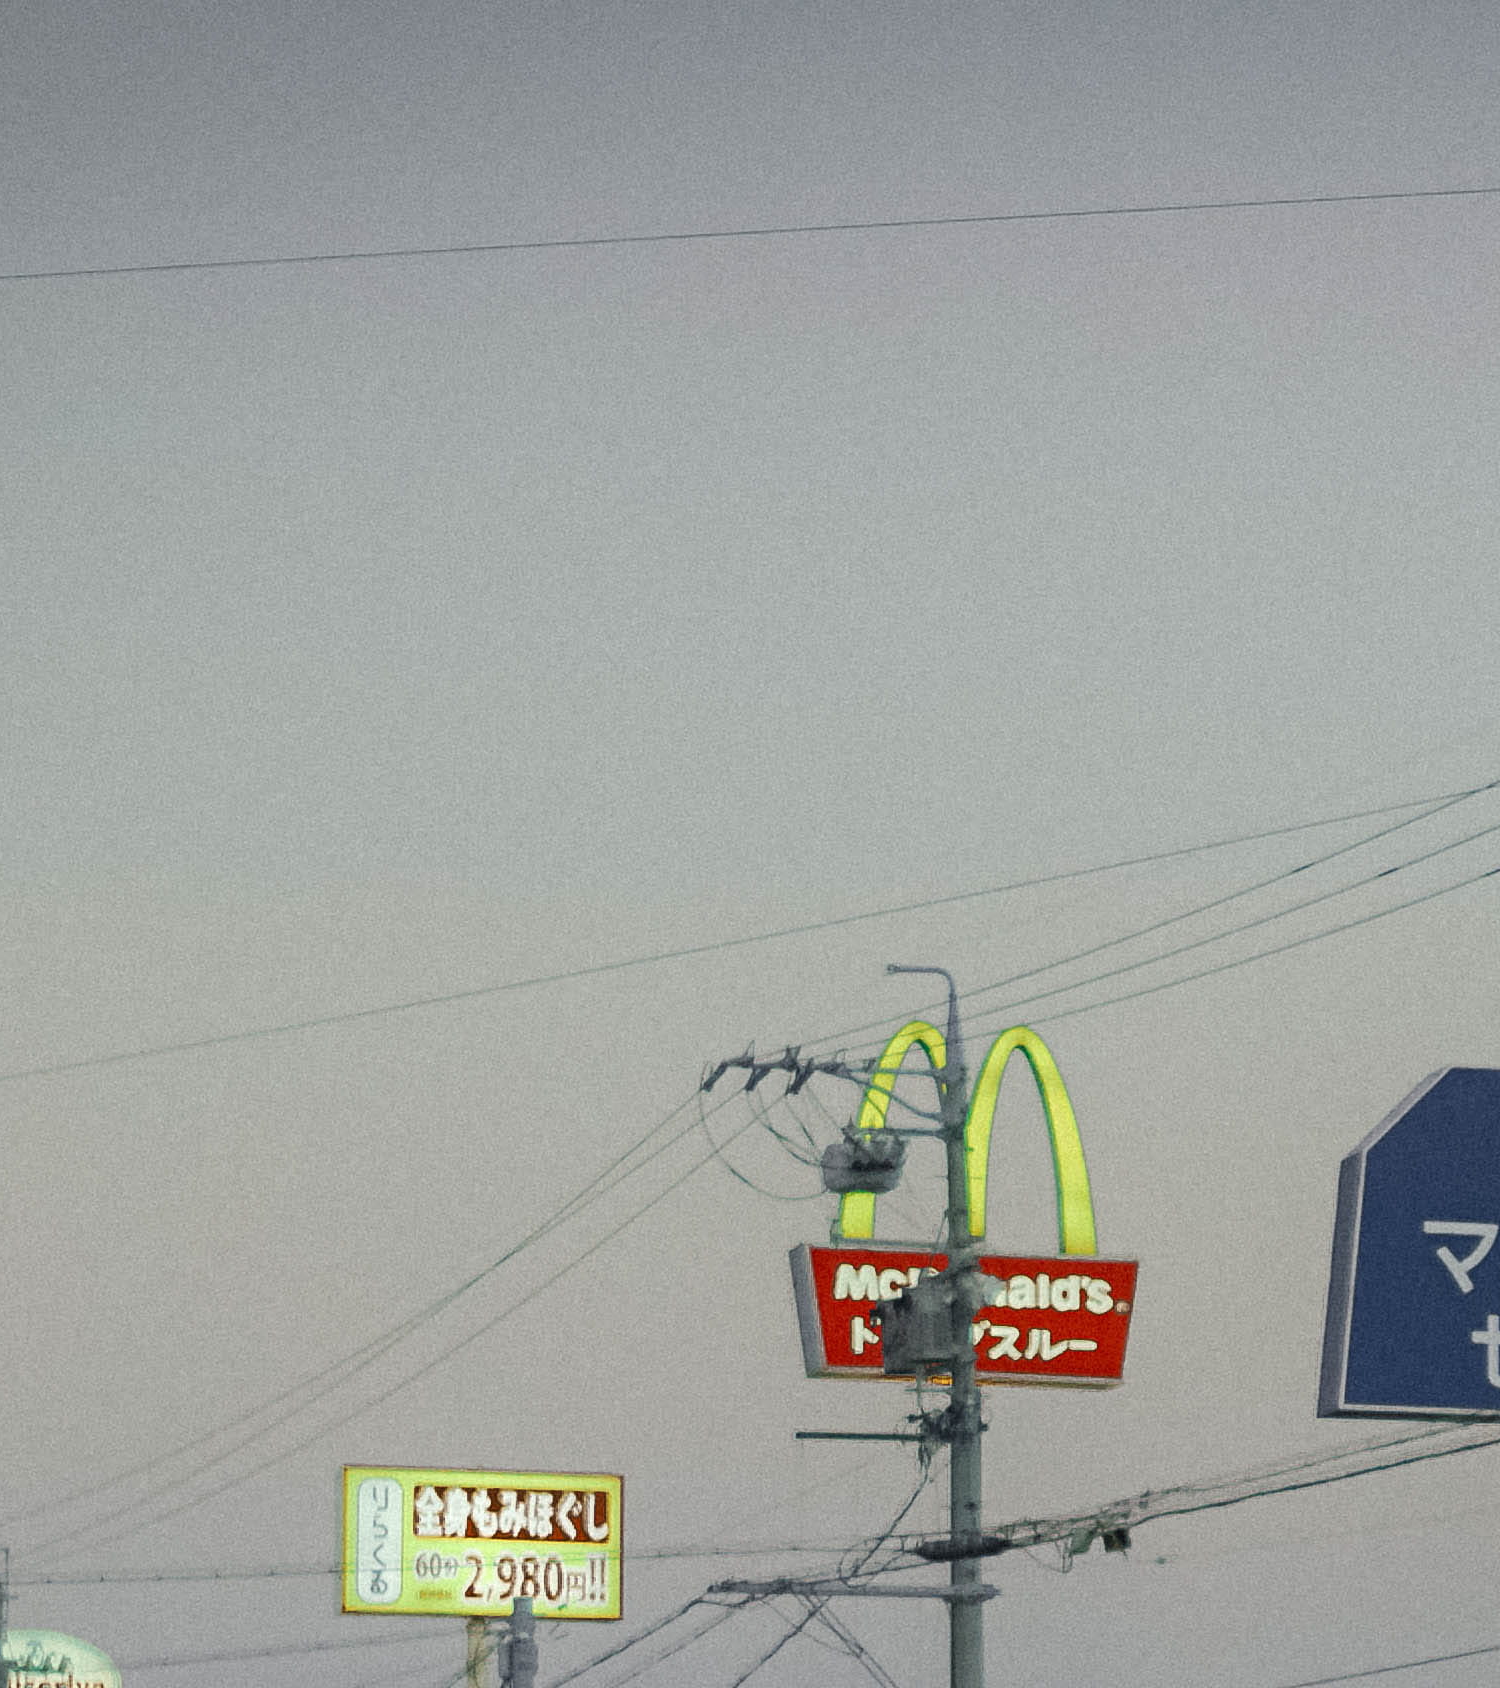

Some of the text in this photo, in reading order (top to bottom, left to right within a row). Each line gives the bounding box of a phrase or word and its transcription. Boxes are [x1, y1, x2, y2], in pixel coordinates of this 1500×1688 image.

[833, 1263, 1114, 1315] Mcald's
[851, 1315, 1098, 1362] ドスルー
[370, 1485, 389, 1595] りらくる
[415, 1485, 610, 1541] 全身もみほぐし
